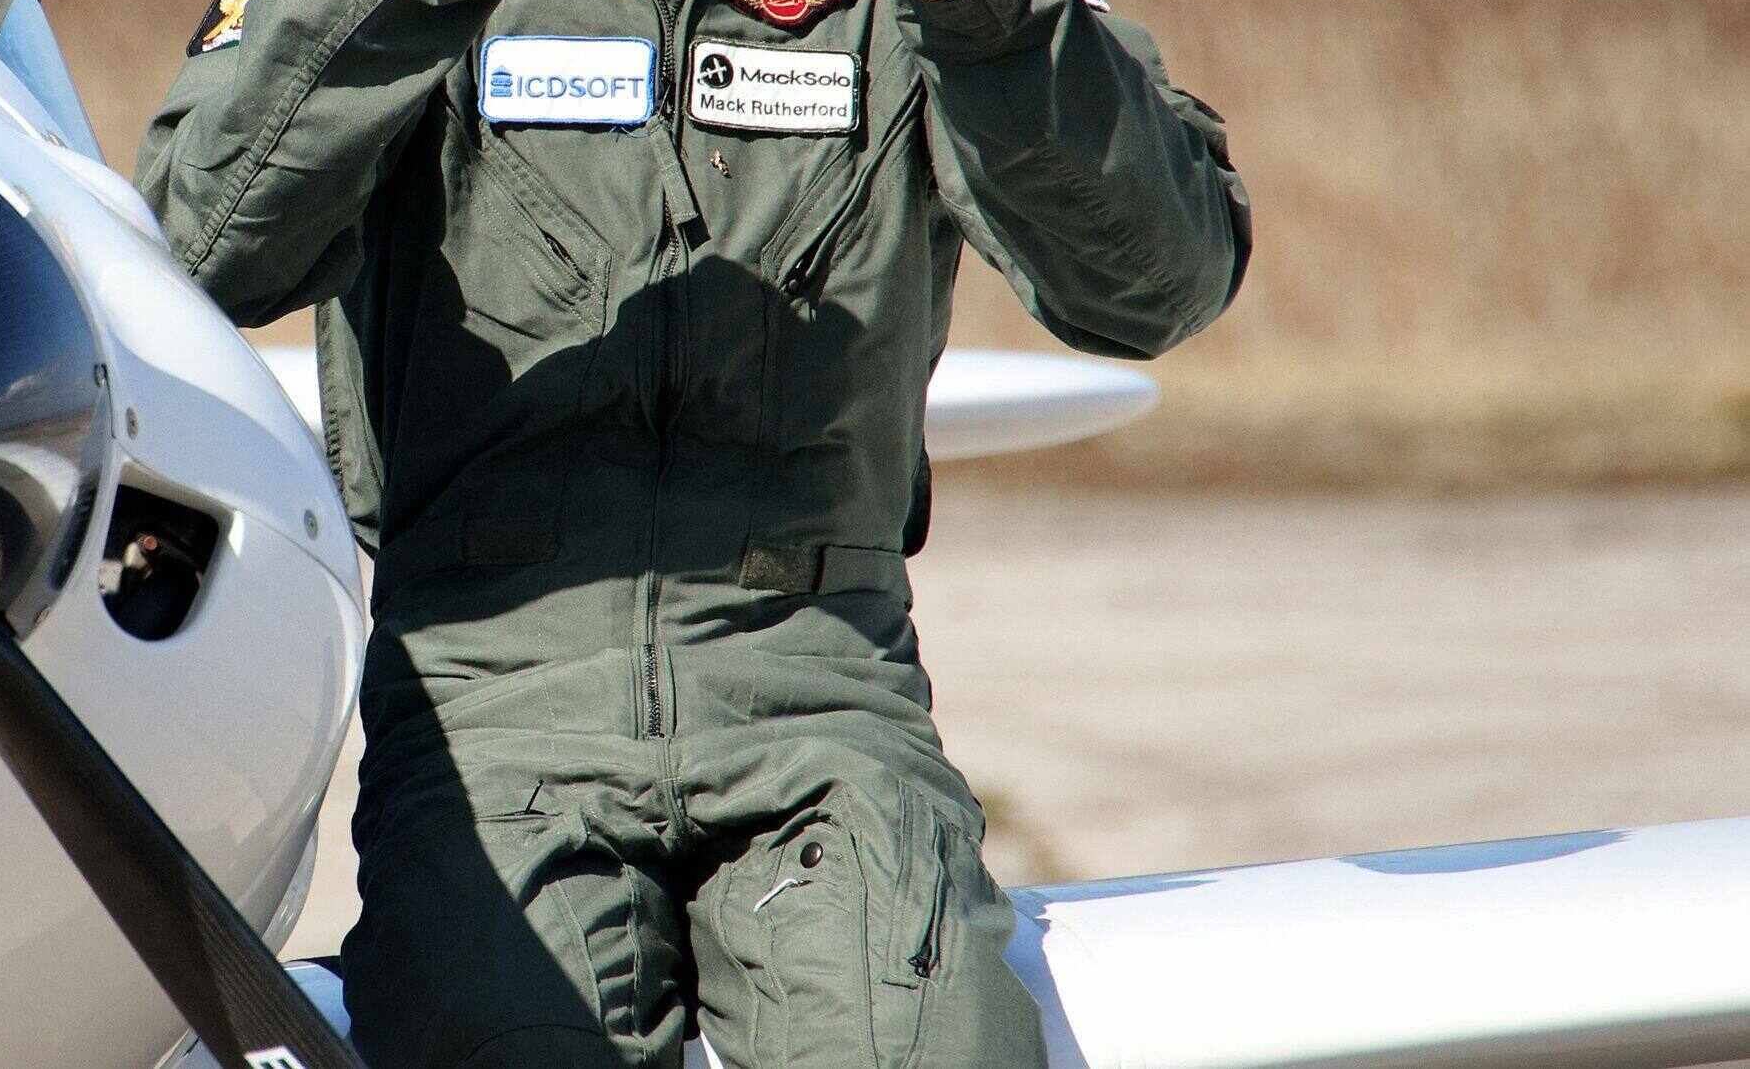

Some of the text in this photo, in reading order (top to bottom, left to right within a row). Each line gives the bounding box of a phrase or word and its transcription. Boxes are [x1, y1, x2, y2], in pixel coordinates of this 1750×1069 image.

[516, 74, 644, 99] ICDSOFT
[740, 67, 851, 88] MackSolo
[701, 93, 847, 117] Mack Rutherford
